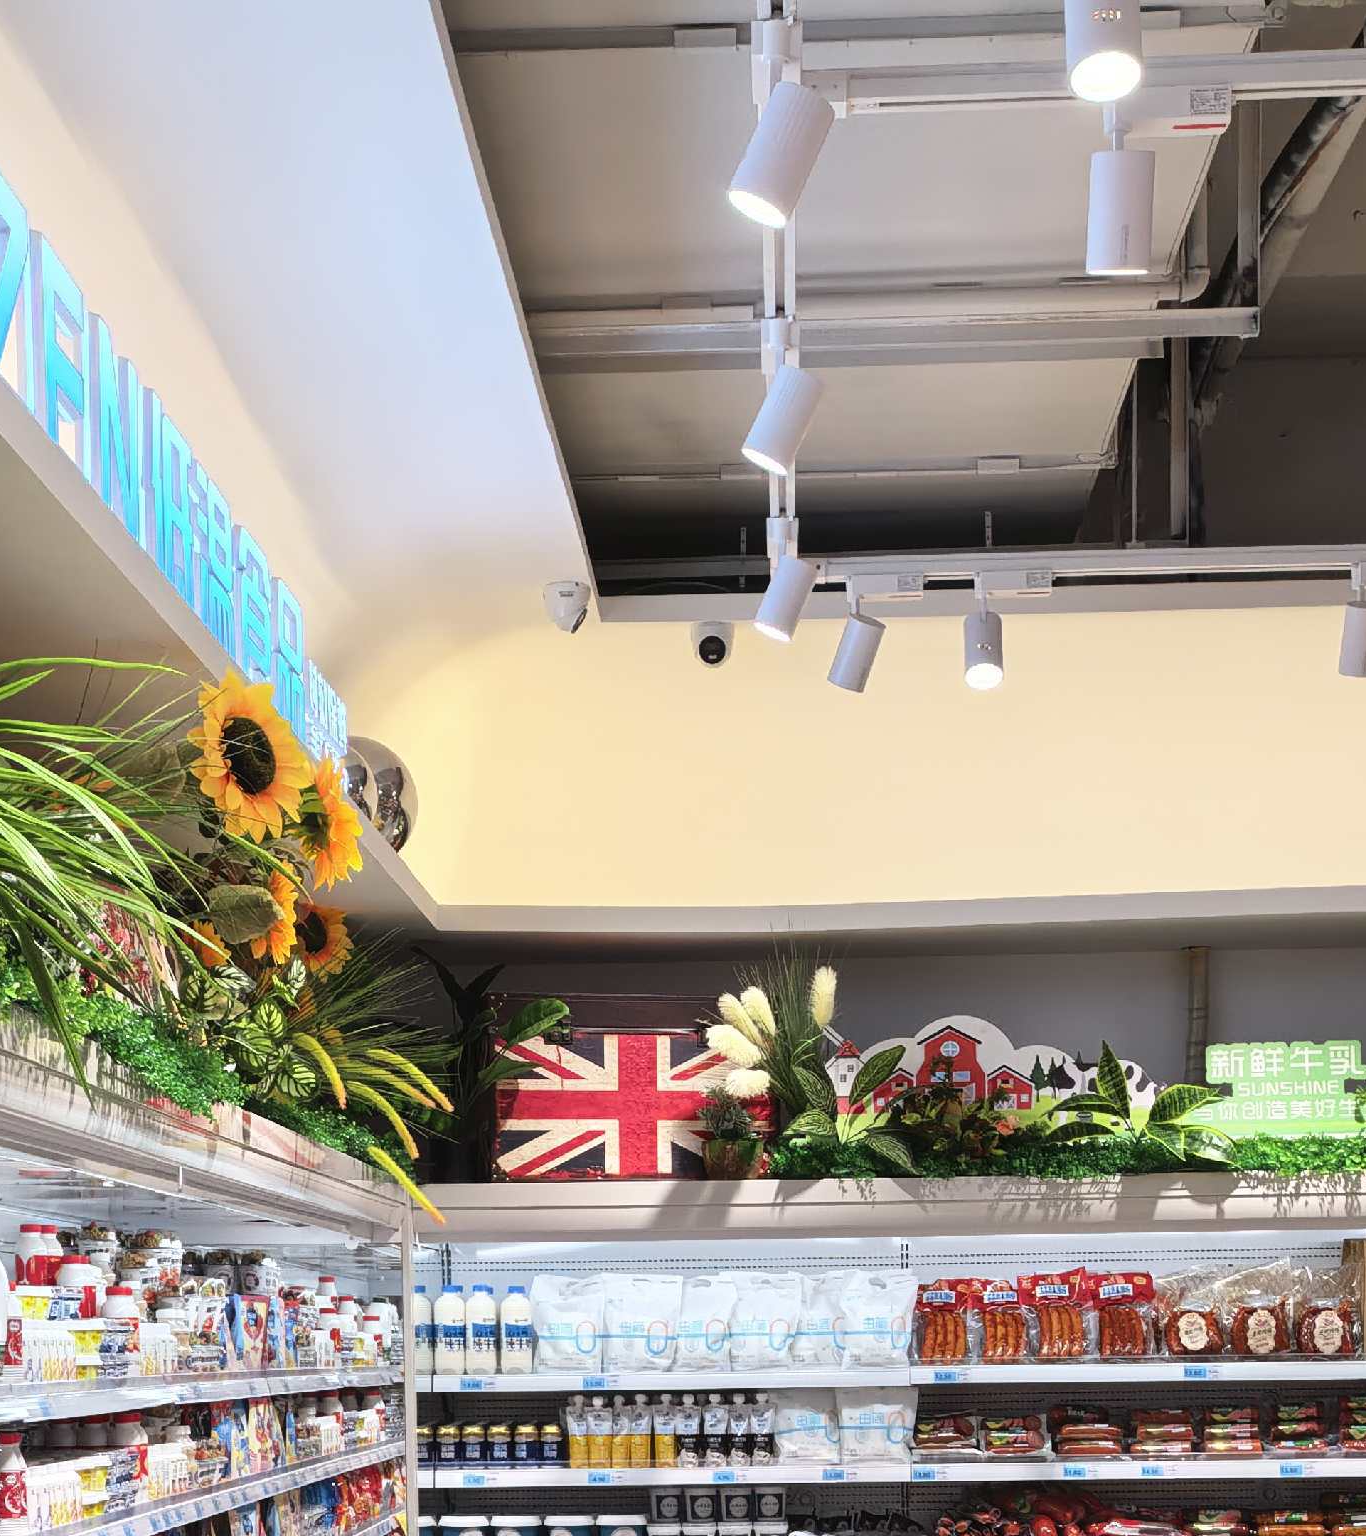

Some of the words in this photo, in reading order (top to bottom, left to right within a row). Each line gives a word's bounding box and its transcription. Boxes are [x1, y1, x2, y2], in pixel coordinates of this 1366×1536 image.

[1210, 1044, 1365, 1078] 新鲜牛乳
[1237, 1080, 1340, 1097] SUNSHINE
